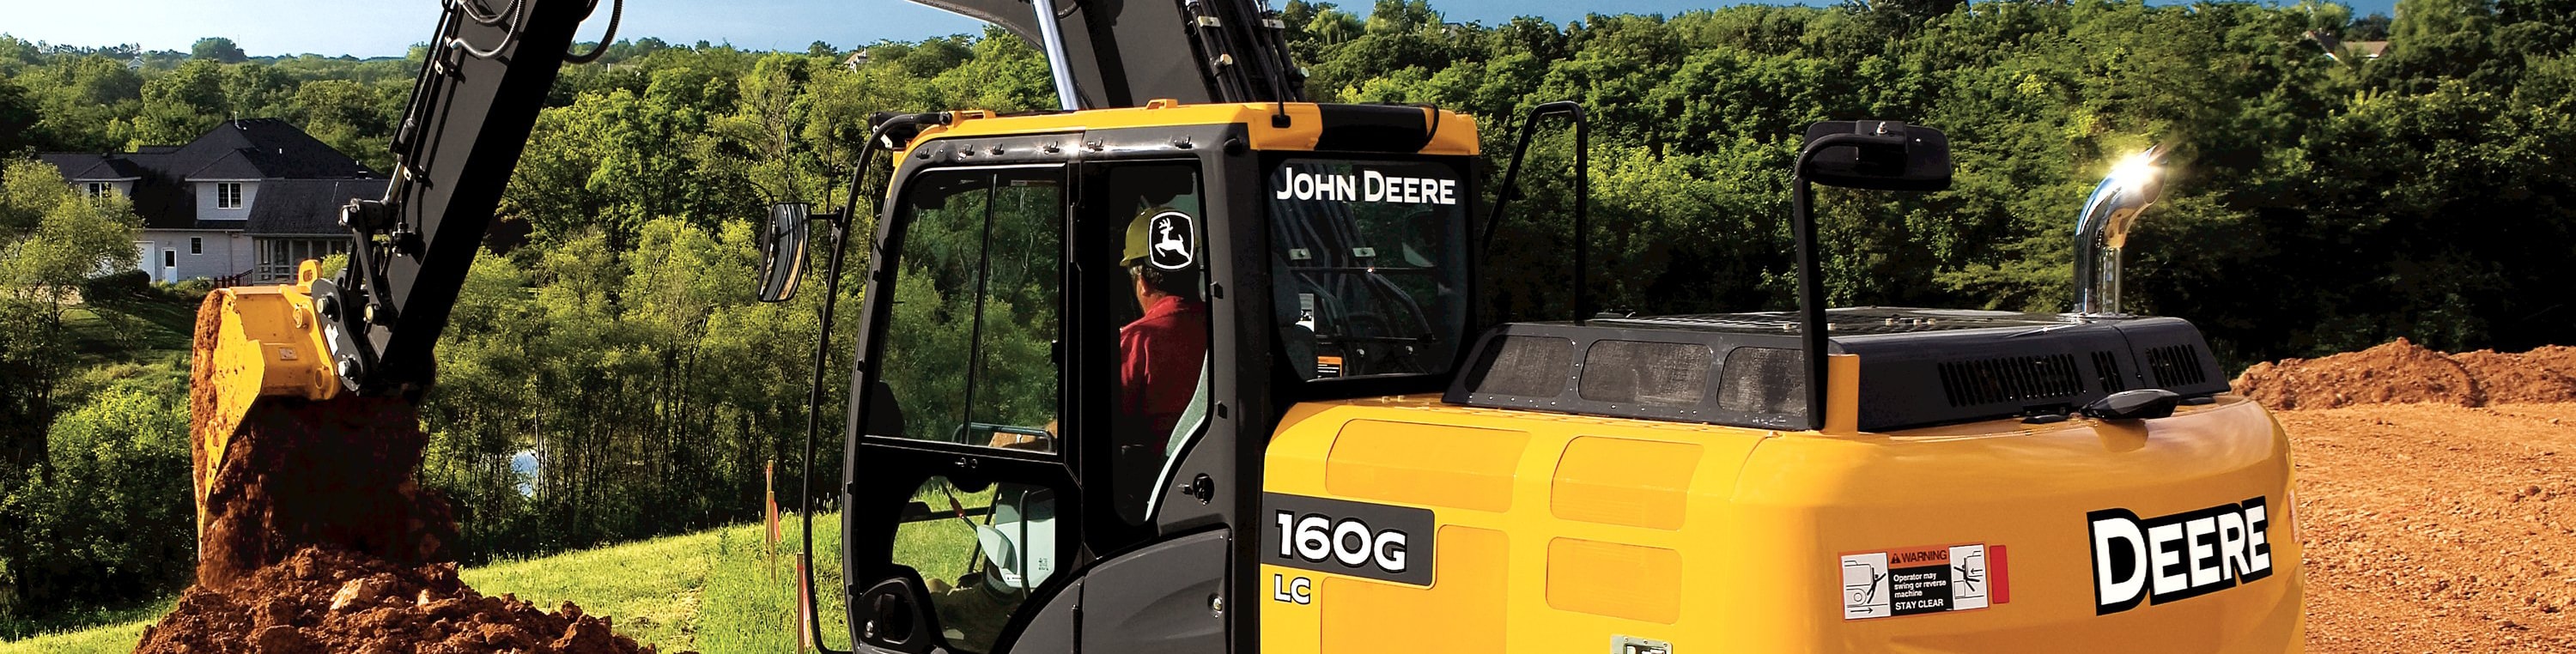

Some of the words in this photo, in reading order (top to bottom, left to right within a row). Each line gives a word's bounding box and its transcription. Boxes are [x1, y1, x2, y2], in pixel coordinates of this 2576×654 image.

[1277, 167, 1356, 201] JOHN
[1364, 170, 1456, 205] DEERE
[1276, 511, 1407, 573] 160G
[1901, 550, 1947, 563] WARNING
[2092, 505, 2271, 606] DEERE
[1274, 573, 1311, 605] LC
[1893, 573, 1923, 583] Operator
[1894, 590, 1923, 598] machine
[1895, 601, 1917, 610] STAY
[1917, 598, 1944, 609] CLEAR
